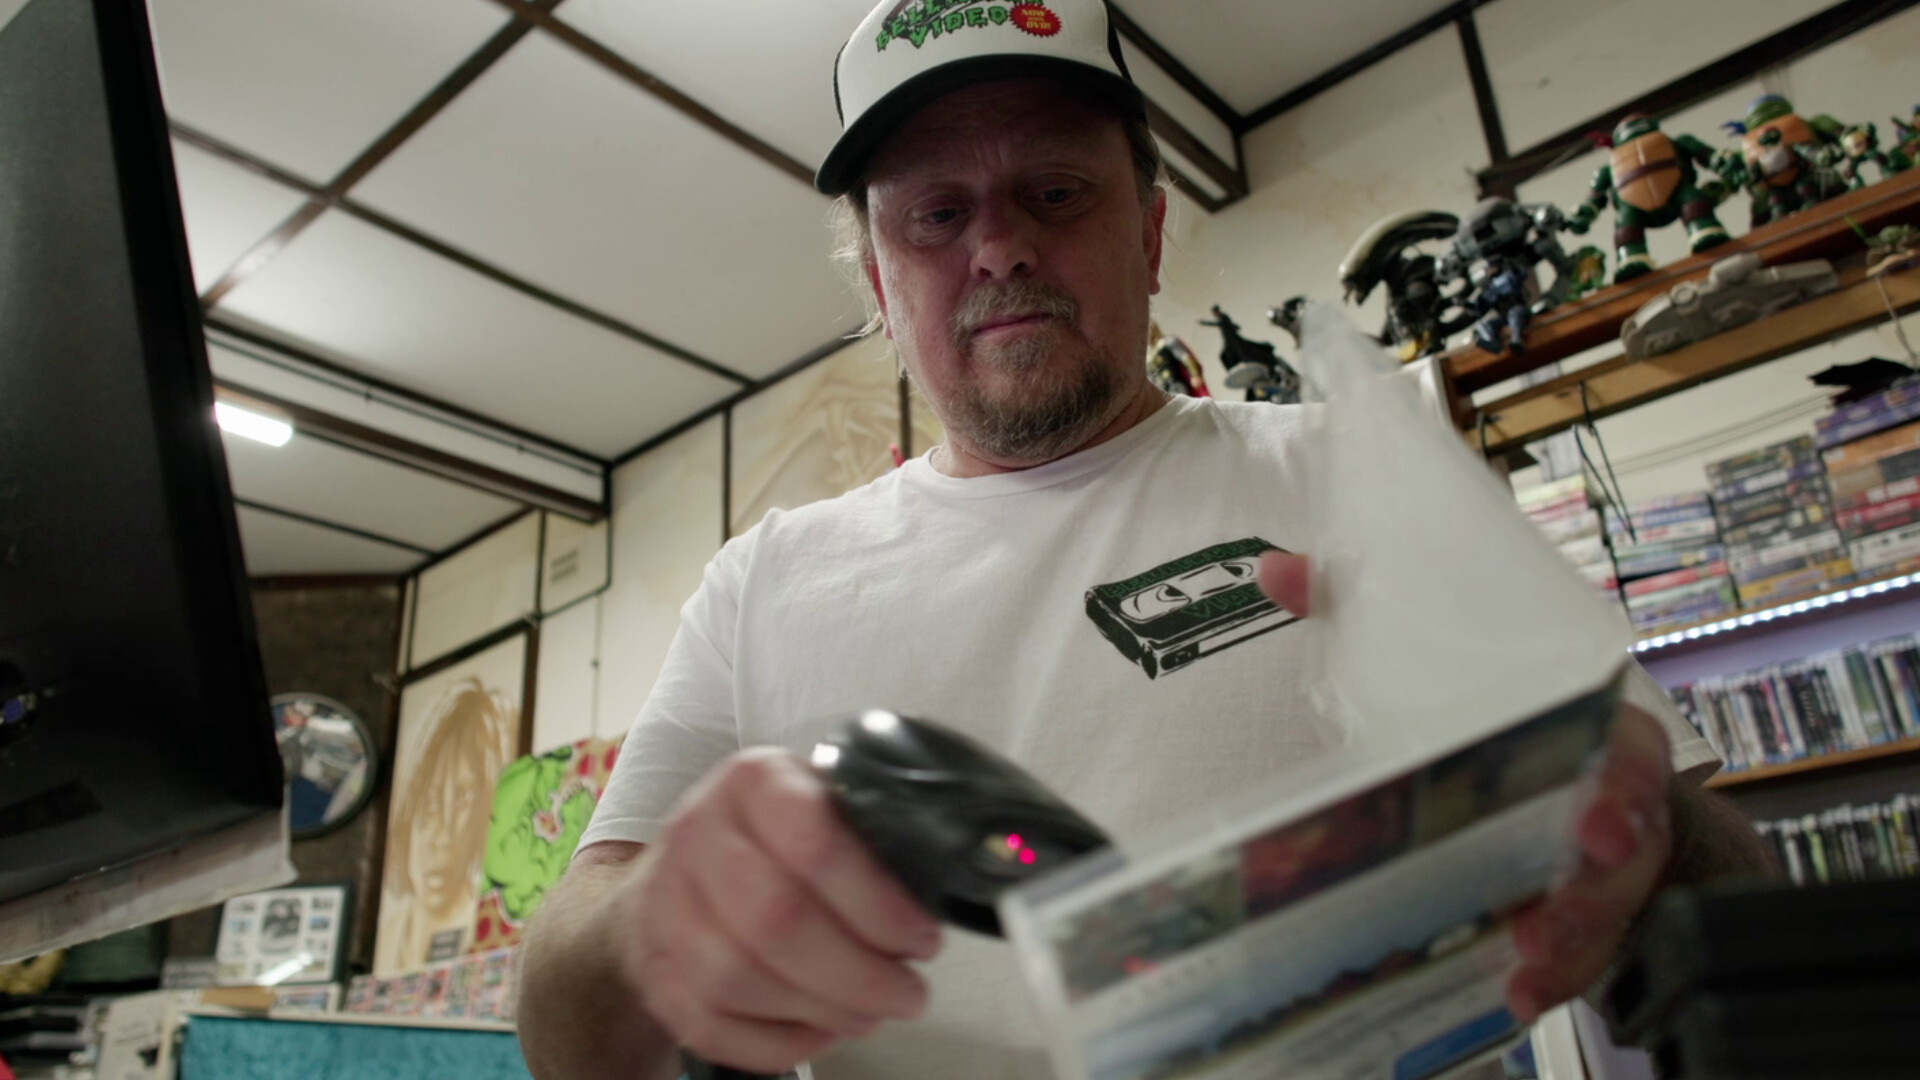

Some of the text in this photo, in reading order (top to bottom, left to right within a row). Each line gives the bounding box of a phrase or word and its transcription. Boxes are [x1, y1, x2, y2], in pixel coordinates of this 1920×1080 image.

[1021, 8, 1045, 16] NOW
[909, 5, 1008, 49] VIDEO
[1026, 21, 1052, 29] DVD!
[1180, 584, 1263, 619] VIDE
